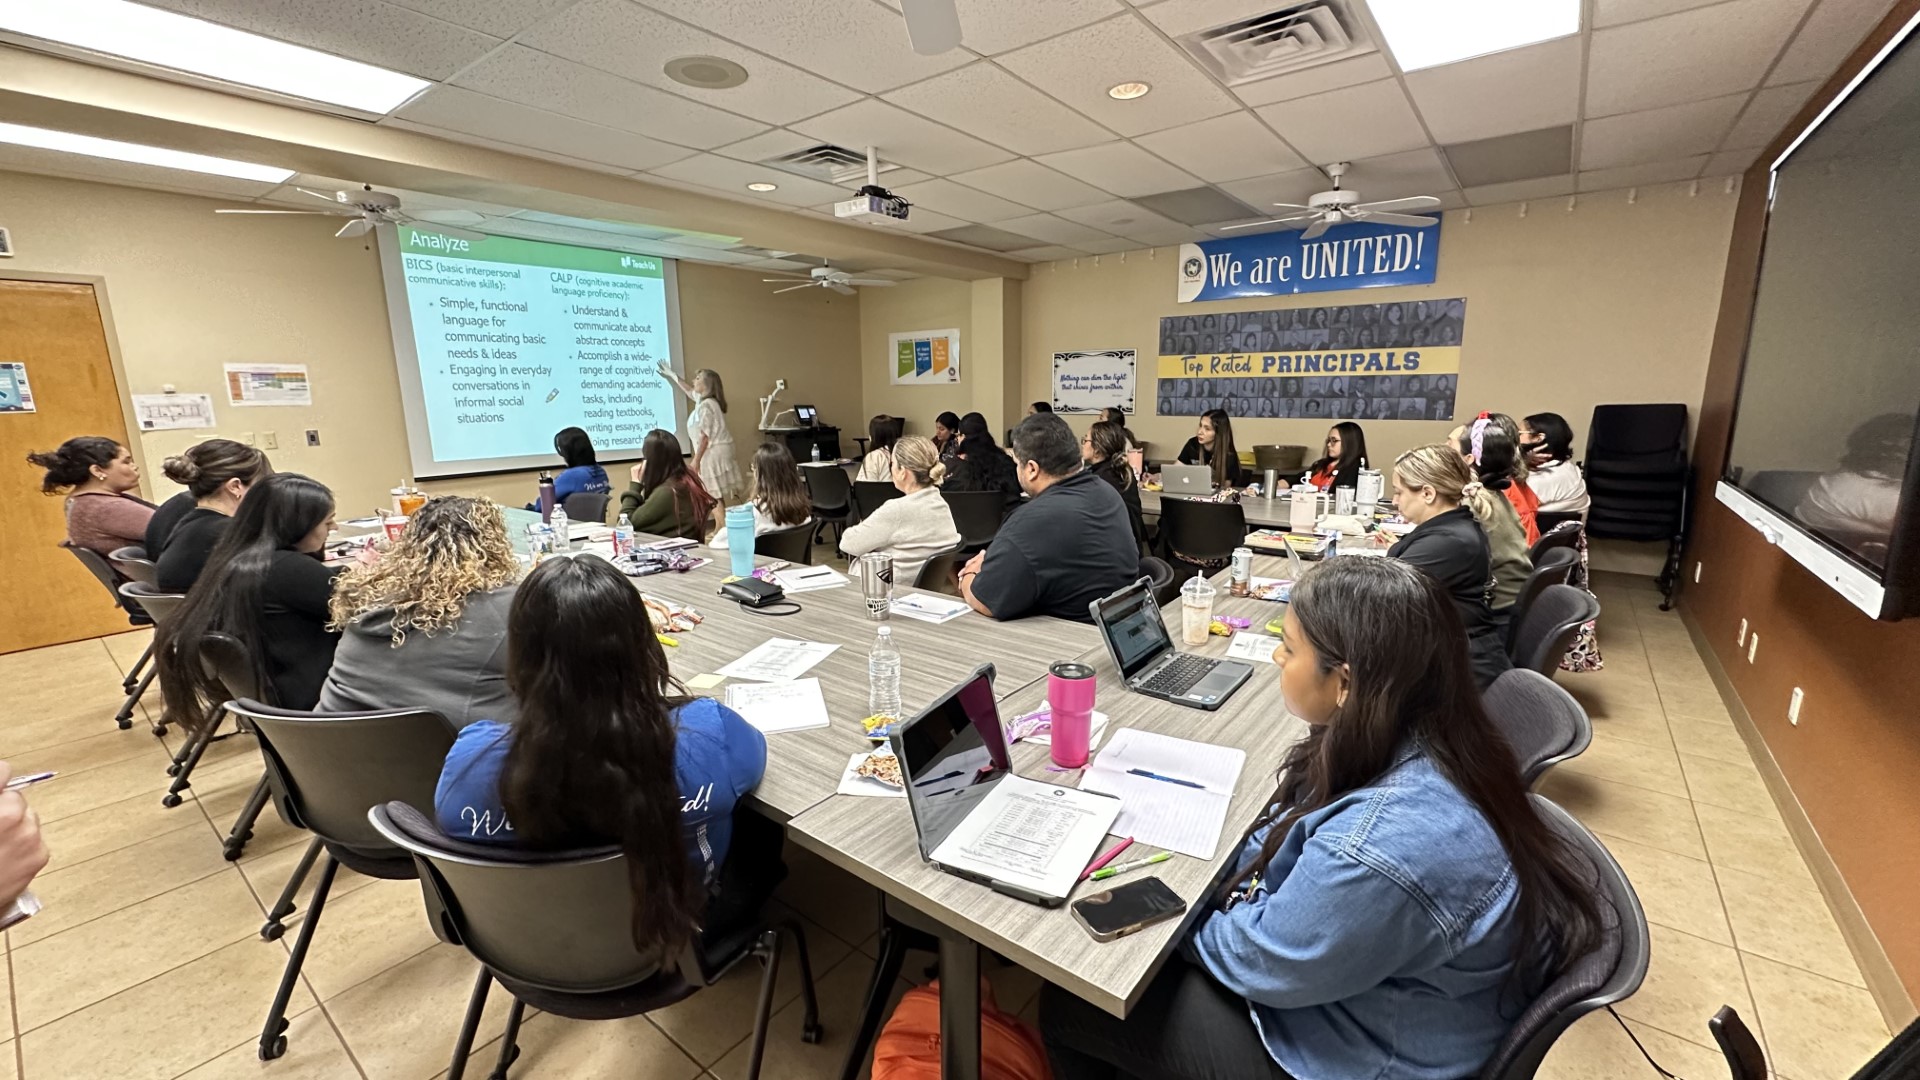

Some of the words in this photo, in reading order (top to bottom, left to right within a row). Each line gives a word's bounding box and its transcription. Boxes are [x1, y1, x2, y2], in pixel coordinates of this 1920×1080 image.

[410, 231, 470, 253] Analyze
[1209, 252, 1242, 288] We
[1249, 255, 1292, 285] are
[1301, 231, 1425, 280] UNITED!
[405, 258, 433, 271] BICS
[436, 262, 464, 274] (basic
[465, 264, 521, 279] interpersonal
[408, 274, 477, 288] communicative
[478, 279, 506, 291] skills):
[550, 271, 573, 284] CALP
[575, 275, 610, 288] (cognitive
[611, 280, 644, 290] academic
[551, 284, 586, 297] language
[587, 288, 630, 301] proficiency):
[439, 296, 478, 312] Simple,
[481, 299, 528, 313] functional
[571, 304, 619, 318] Understand
[621, 308, 628, 318] &
[442, 313, 489, 328] language
[491, 315, 506, 327] for
[573, 321, 628, 332] communicate
[629, 324, 652, 333] about
[444, 332, 520, 345] communicating
[522, 333, 546, 344] basic
[575, 334, 608, 345] abstract
[610, 337, 645, 348] concepts
[447, 347, 479, 359] needs
[481, 348, 490, 359] &
[491, 348, 517, 360] ideas
[577, 350, 622, 362] Accomplish
[624, 353, 630, 361] a
[631, 353, 652, 361] wide-
[449, 364, 497, 377] Engaging
[499, 364, 508, 375] in
[510, 364, 552, 377] everyday
[579, 366, 603, 377] range
[604, 364, 613, 375] of
[614, 365, 655, 377] cognitively
[1180, 354, 1204, 378] Top
[1209, 354, 1252, 374] Rated
[1261, 351, 1420, 374] PRINCIPALS
[1060, 373, 1080, 384] Nothing
[1090, 373, 1102, 381] dim
[1103, 373, 1112, 381] the
[1112, 372, 1127, 384] light
[452, 380, 520, 391] conversations
[521, 380, 531, 390] in
[580, 380, 625, 391] demanding
[626, 380, 662, 389] academic
[1061, 383, 1073, 391] that
[1073, 383, 1089, 391] shines
[1089, 383, 1104, 394] from
[454, 396, 496, 407] informal
[498, 395, 525, 407] social
[582, 394, 606, 405] tasks,
[607, 393, 643, 405] including
[457, 413, 505, 424] situations
[584, 408, 614, 419] reading
[615, 407, 655, 418] textbooks,
[585, 422, 613, 433] writing
[615, 422, 643, 433] essays,
[592, 437, 610, 448] oing
